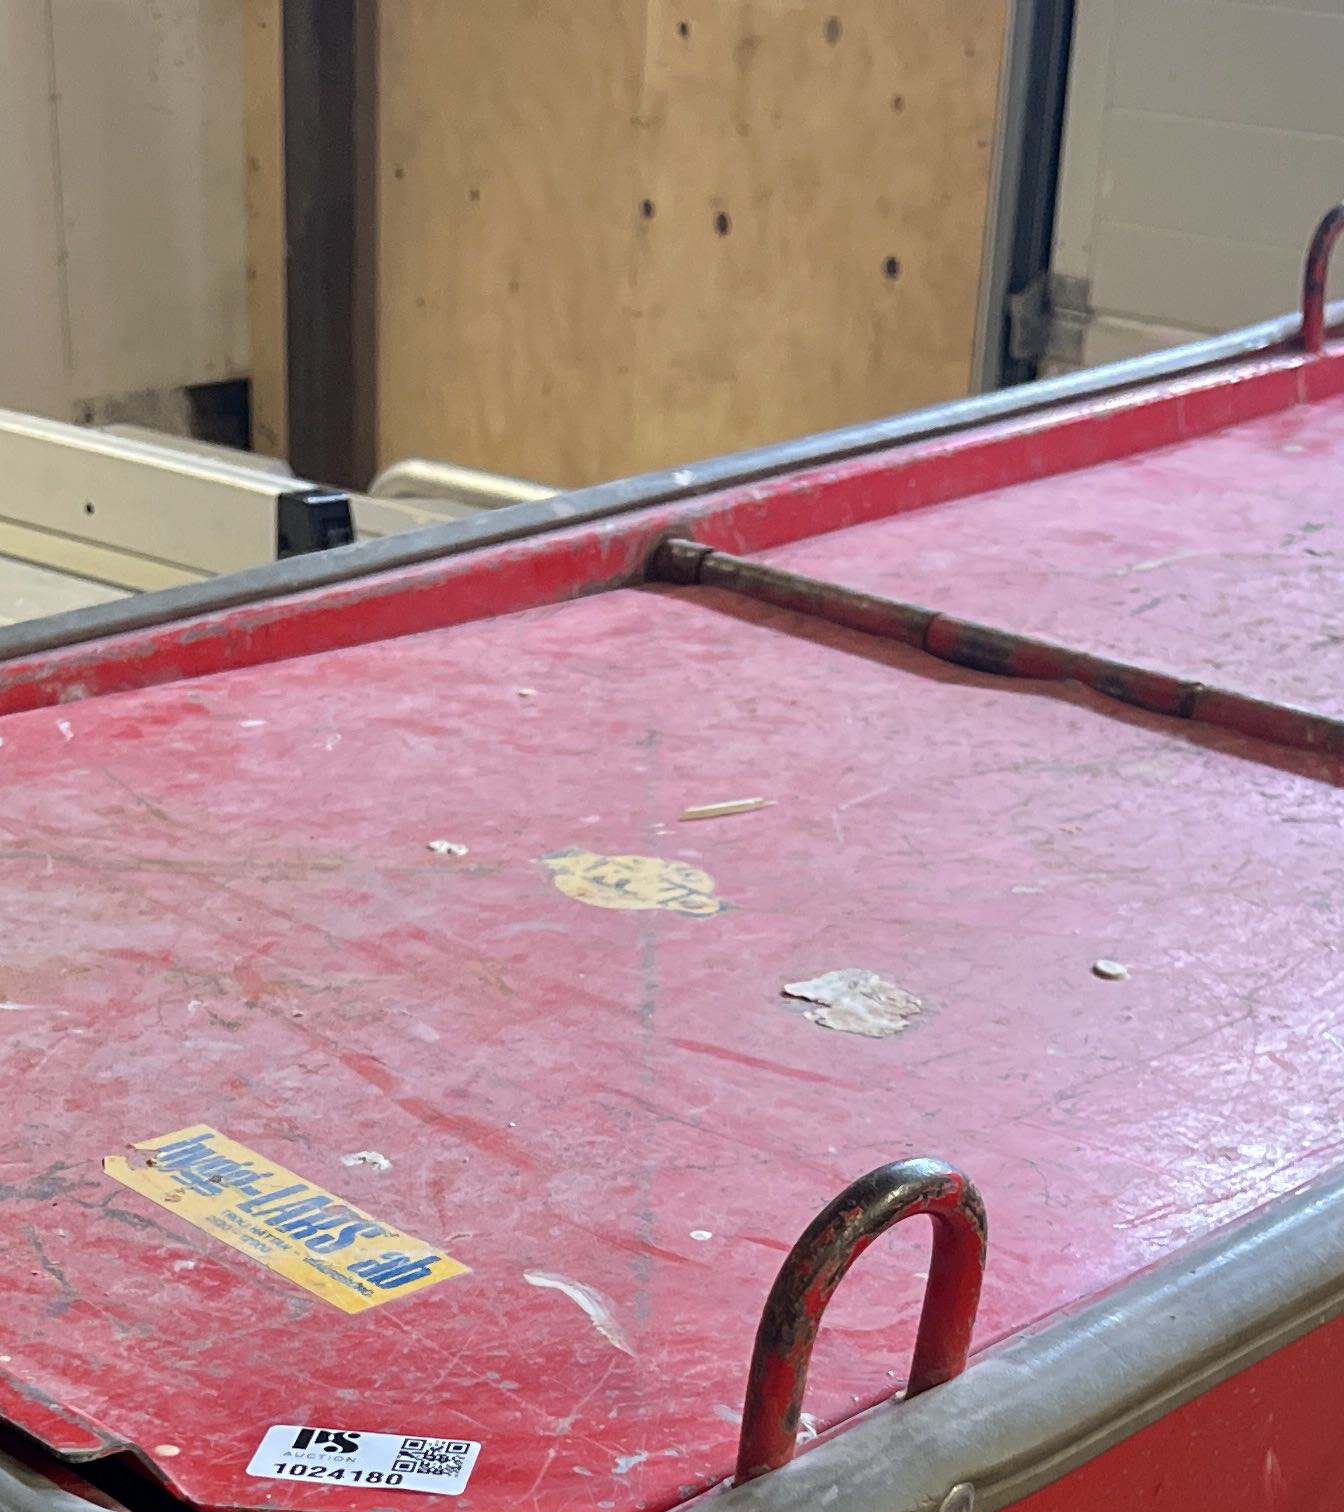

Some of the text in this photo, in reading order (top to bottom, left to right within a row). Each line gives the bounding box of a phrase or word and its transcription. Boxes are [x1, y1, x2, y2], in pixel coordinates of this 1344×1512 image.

[346, 1251, 442, 1290] ab
[282, 1450, 357, 1463] AUCTION
[273, 1462, 404, 1486] 1024180
